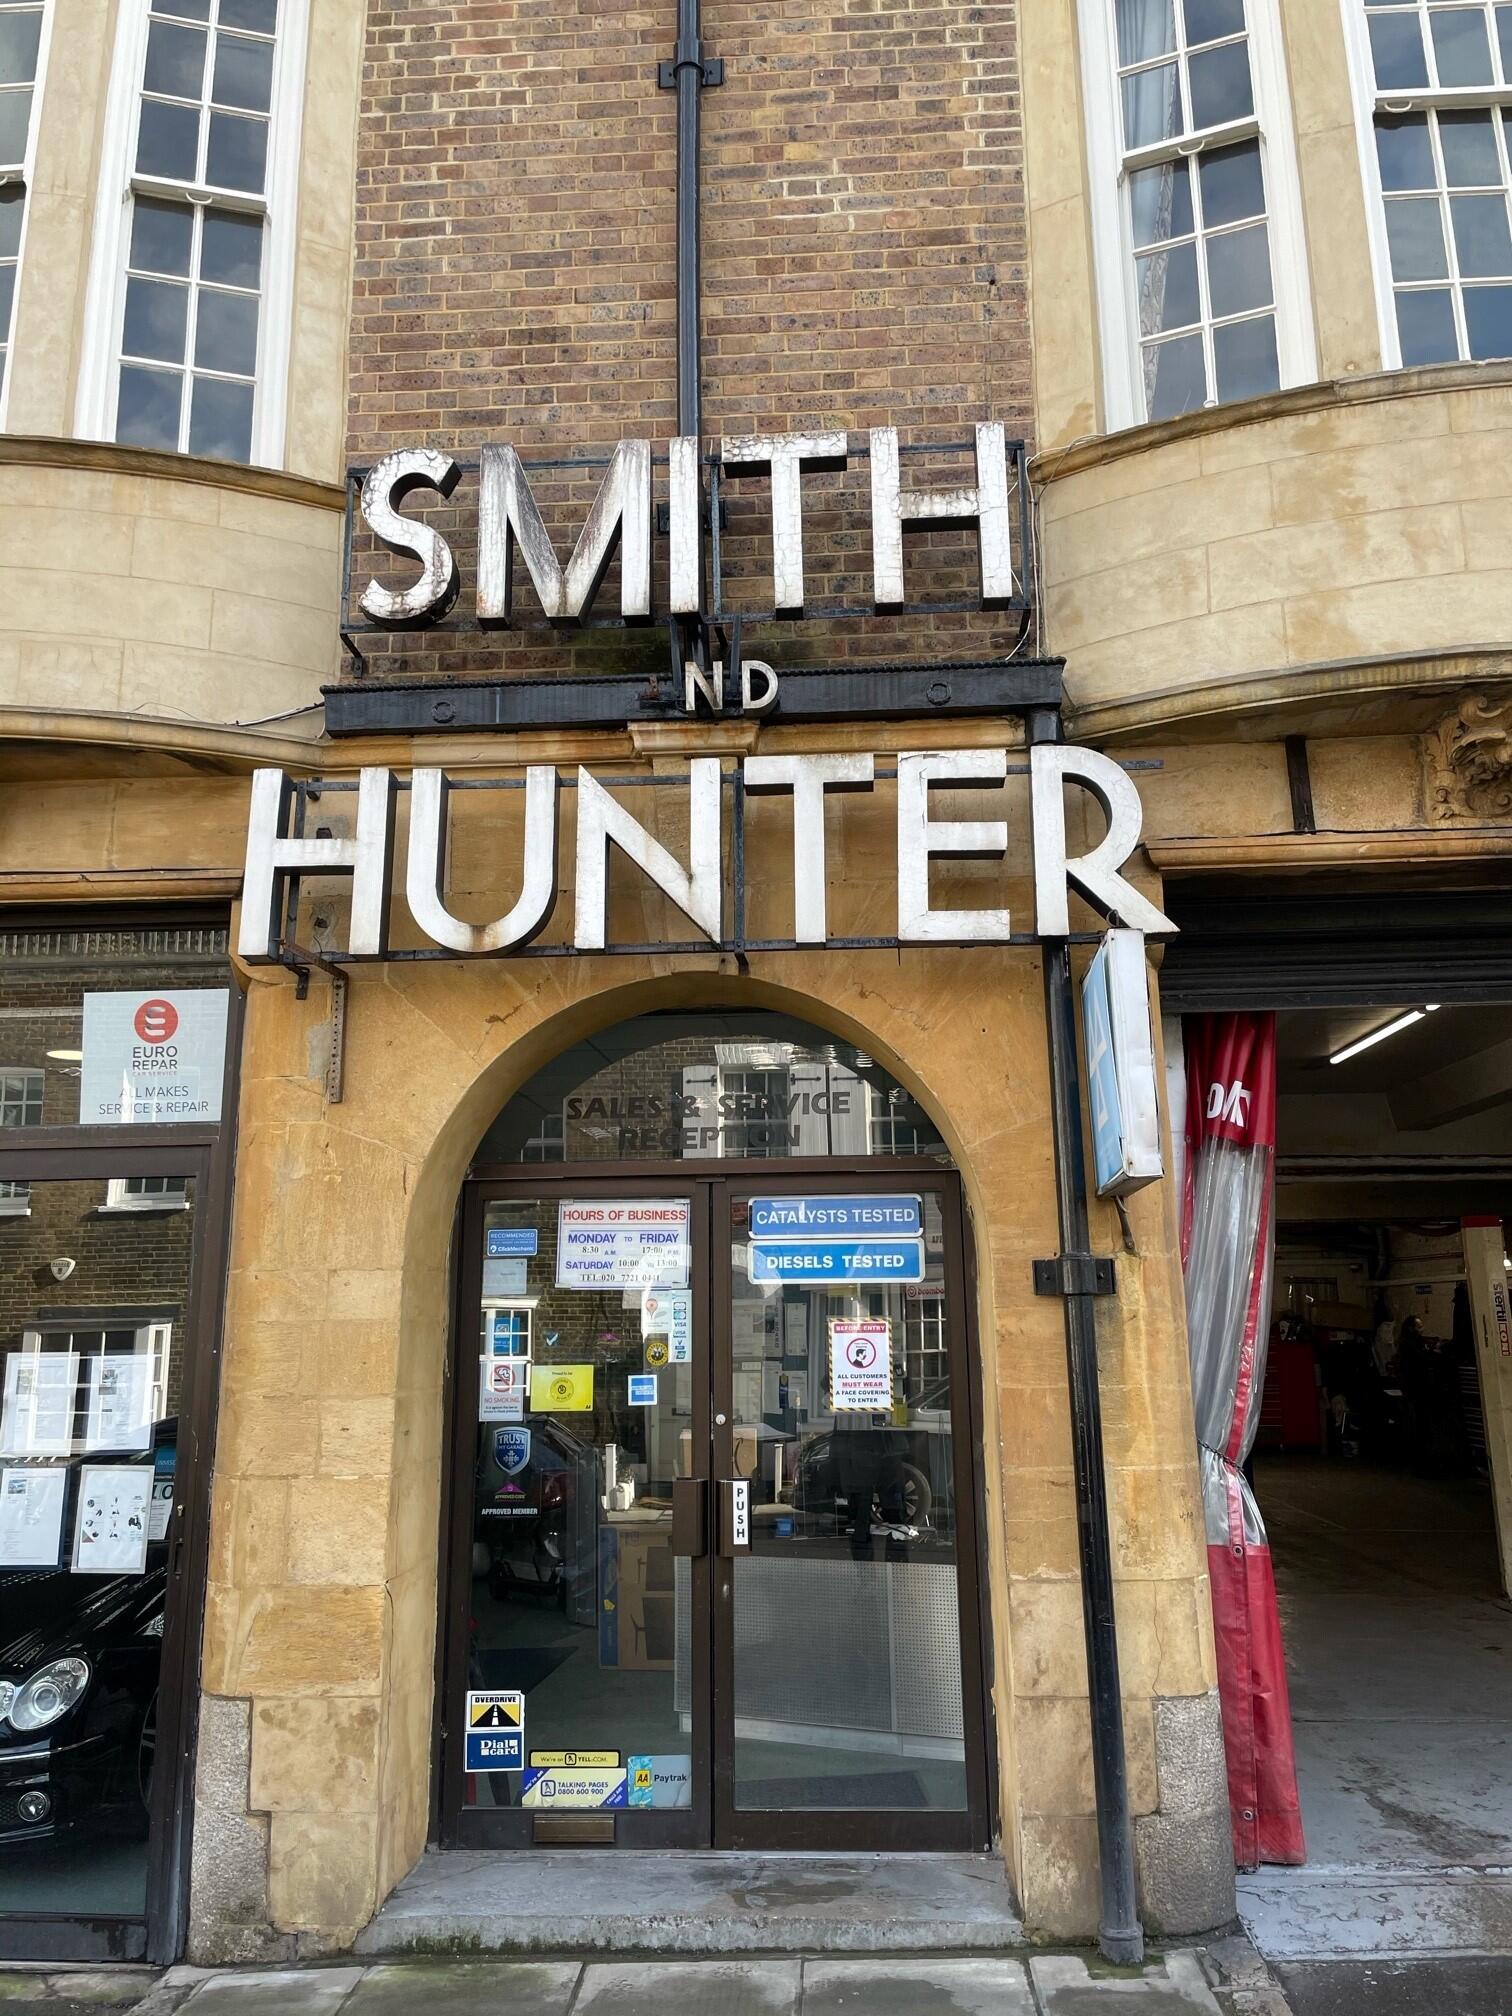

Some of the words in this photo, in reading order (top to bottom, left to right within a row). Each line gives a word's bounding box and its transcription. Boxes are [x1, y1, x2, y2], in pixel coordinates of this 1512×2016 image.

[358, 421, 1014, 629] SMITH
[238, 744, 1180, 962] HUNTER
[132, 1045, 178, 1059] EURO
[132, 1059, 178, 1071] REPAR
[145, 1085, 189, 1098] MAKES
[98, 1102, 150, 1115] SERICE
[154, 1102, 163, 1114] &
[166, 1100, 209, 1113] REPAIR
[567, 1095, 664, 1120] SALES
[681, 1095, 702, 1118] &
[718, 1091, 851, 1117] SERVICE
[619, 1124, 801, 1151] RECEPTION
[563, 1209, 604, 1221] HOURS
[608, 1209, 625, 1220] OF
[627, 1209, 687, 1221] BUSINESS
[756, 1209, 848, 1224] CATALYSTS
[852, 1208, 915, 1223] TESTED
[568, 1233, 617, 1244] MONDAY
[639, 1233, 679, 1243] FRIDAY
[565, 1260, 614, 1270] SATURDAY
[618, 1259, 639, 1267] 10:00
[766, 1256, 833, 1269] DIESELS
[842, 1255, 905, 1268] TESTED
[498, 1433, 526, 1444] TRUST
[736, 1487, 745, 1538] PUSH
[474, 1696, 517, 1704] OVERDRIVE
[480, 1739, 509, 1749] Dial
[489, 1746, 519, 1756] card
[636, 1773, 649, 1783] AA
[654, 1773, 687, 1783] Paytrak
